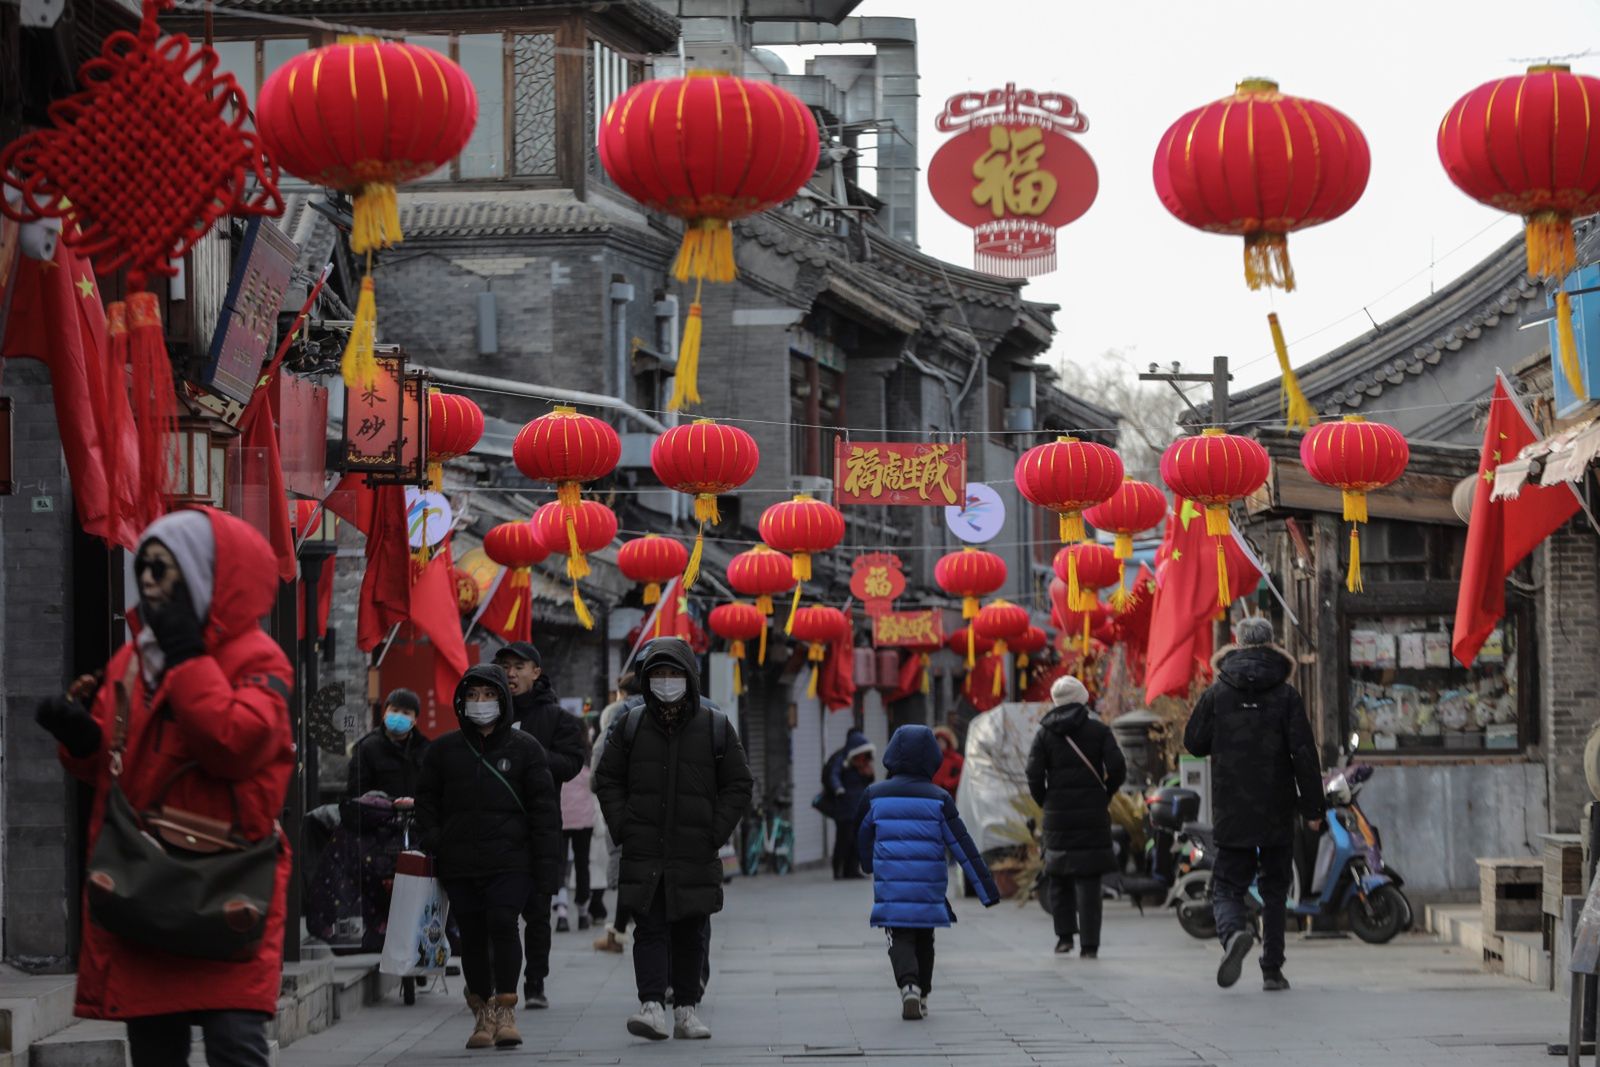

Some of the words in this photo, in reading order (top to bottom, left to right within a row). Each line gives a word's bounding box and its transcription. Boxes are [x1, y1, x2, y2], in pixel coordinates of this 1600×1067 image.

[971, 125, 1058, 218] 福
[844, 444, 958, 504] 福虎生威
